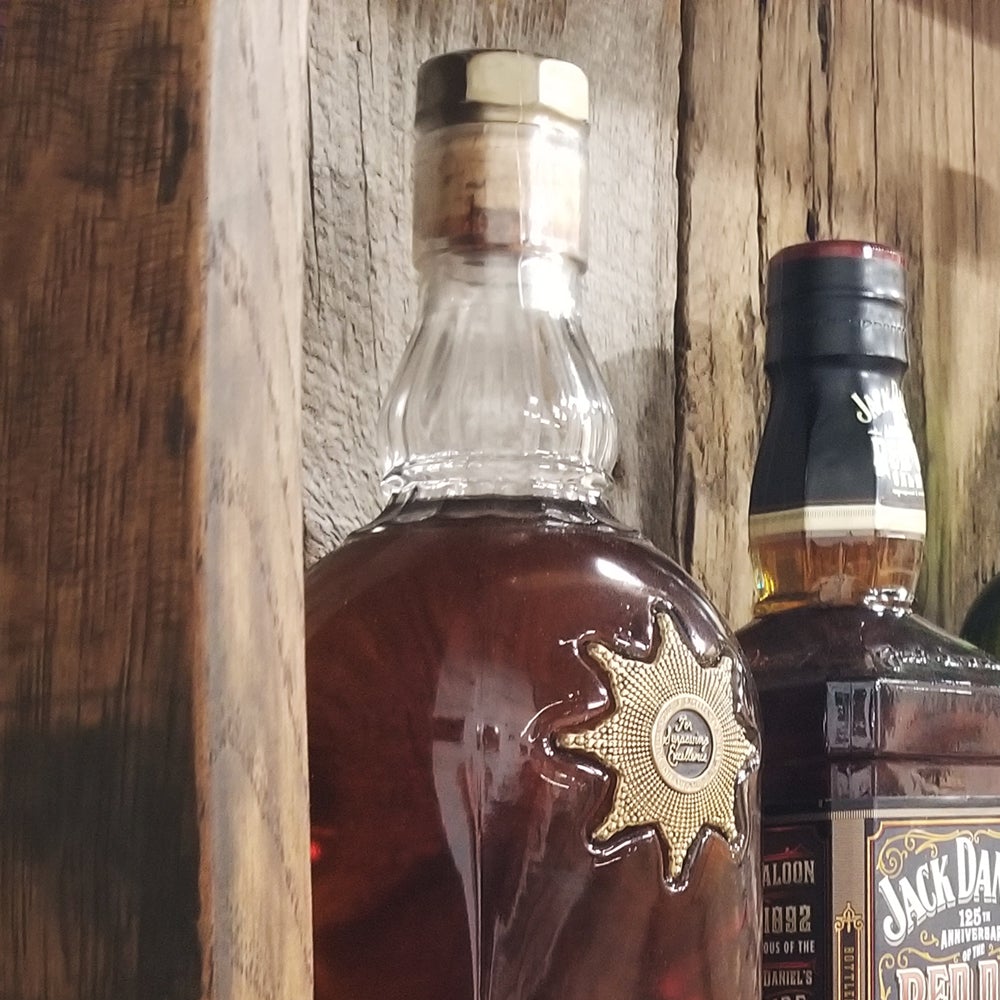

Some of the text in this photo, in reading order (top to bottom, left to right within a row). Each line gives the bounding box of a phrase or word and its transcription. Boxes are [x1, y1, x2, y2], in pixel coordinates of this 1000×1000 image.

[763, 860, 815, 887] ALOON
[878, 853, 957, 947] JACK
[763, 940, 815, 954] OUS OF THE
[962, 943, 986, 962] OF THE
[763, 969, 813, 987] DANIEL'S
